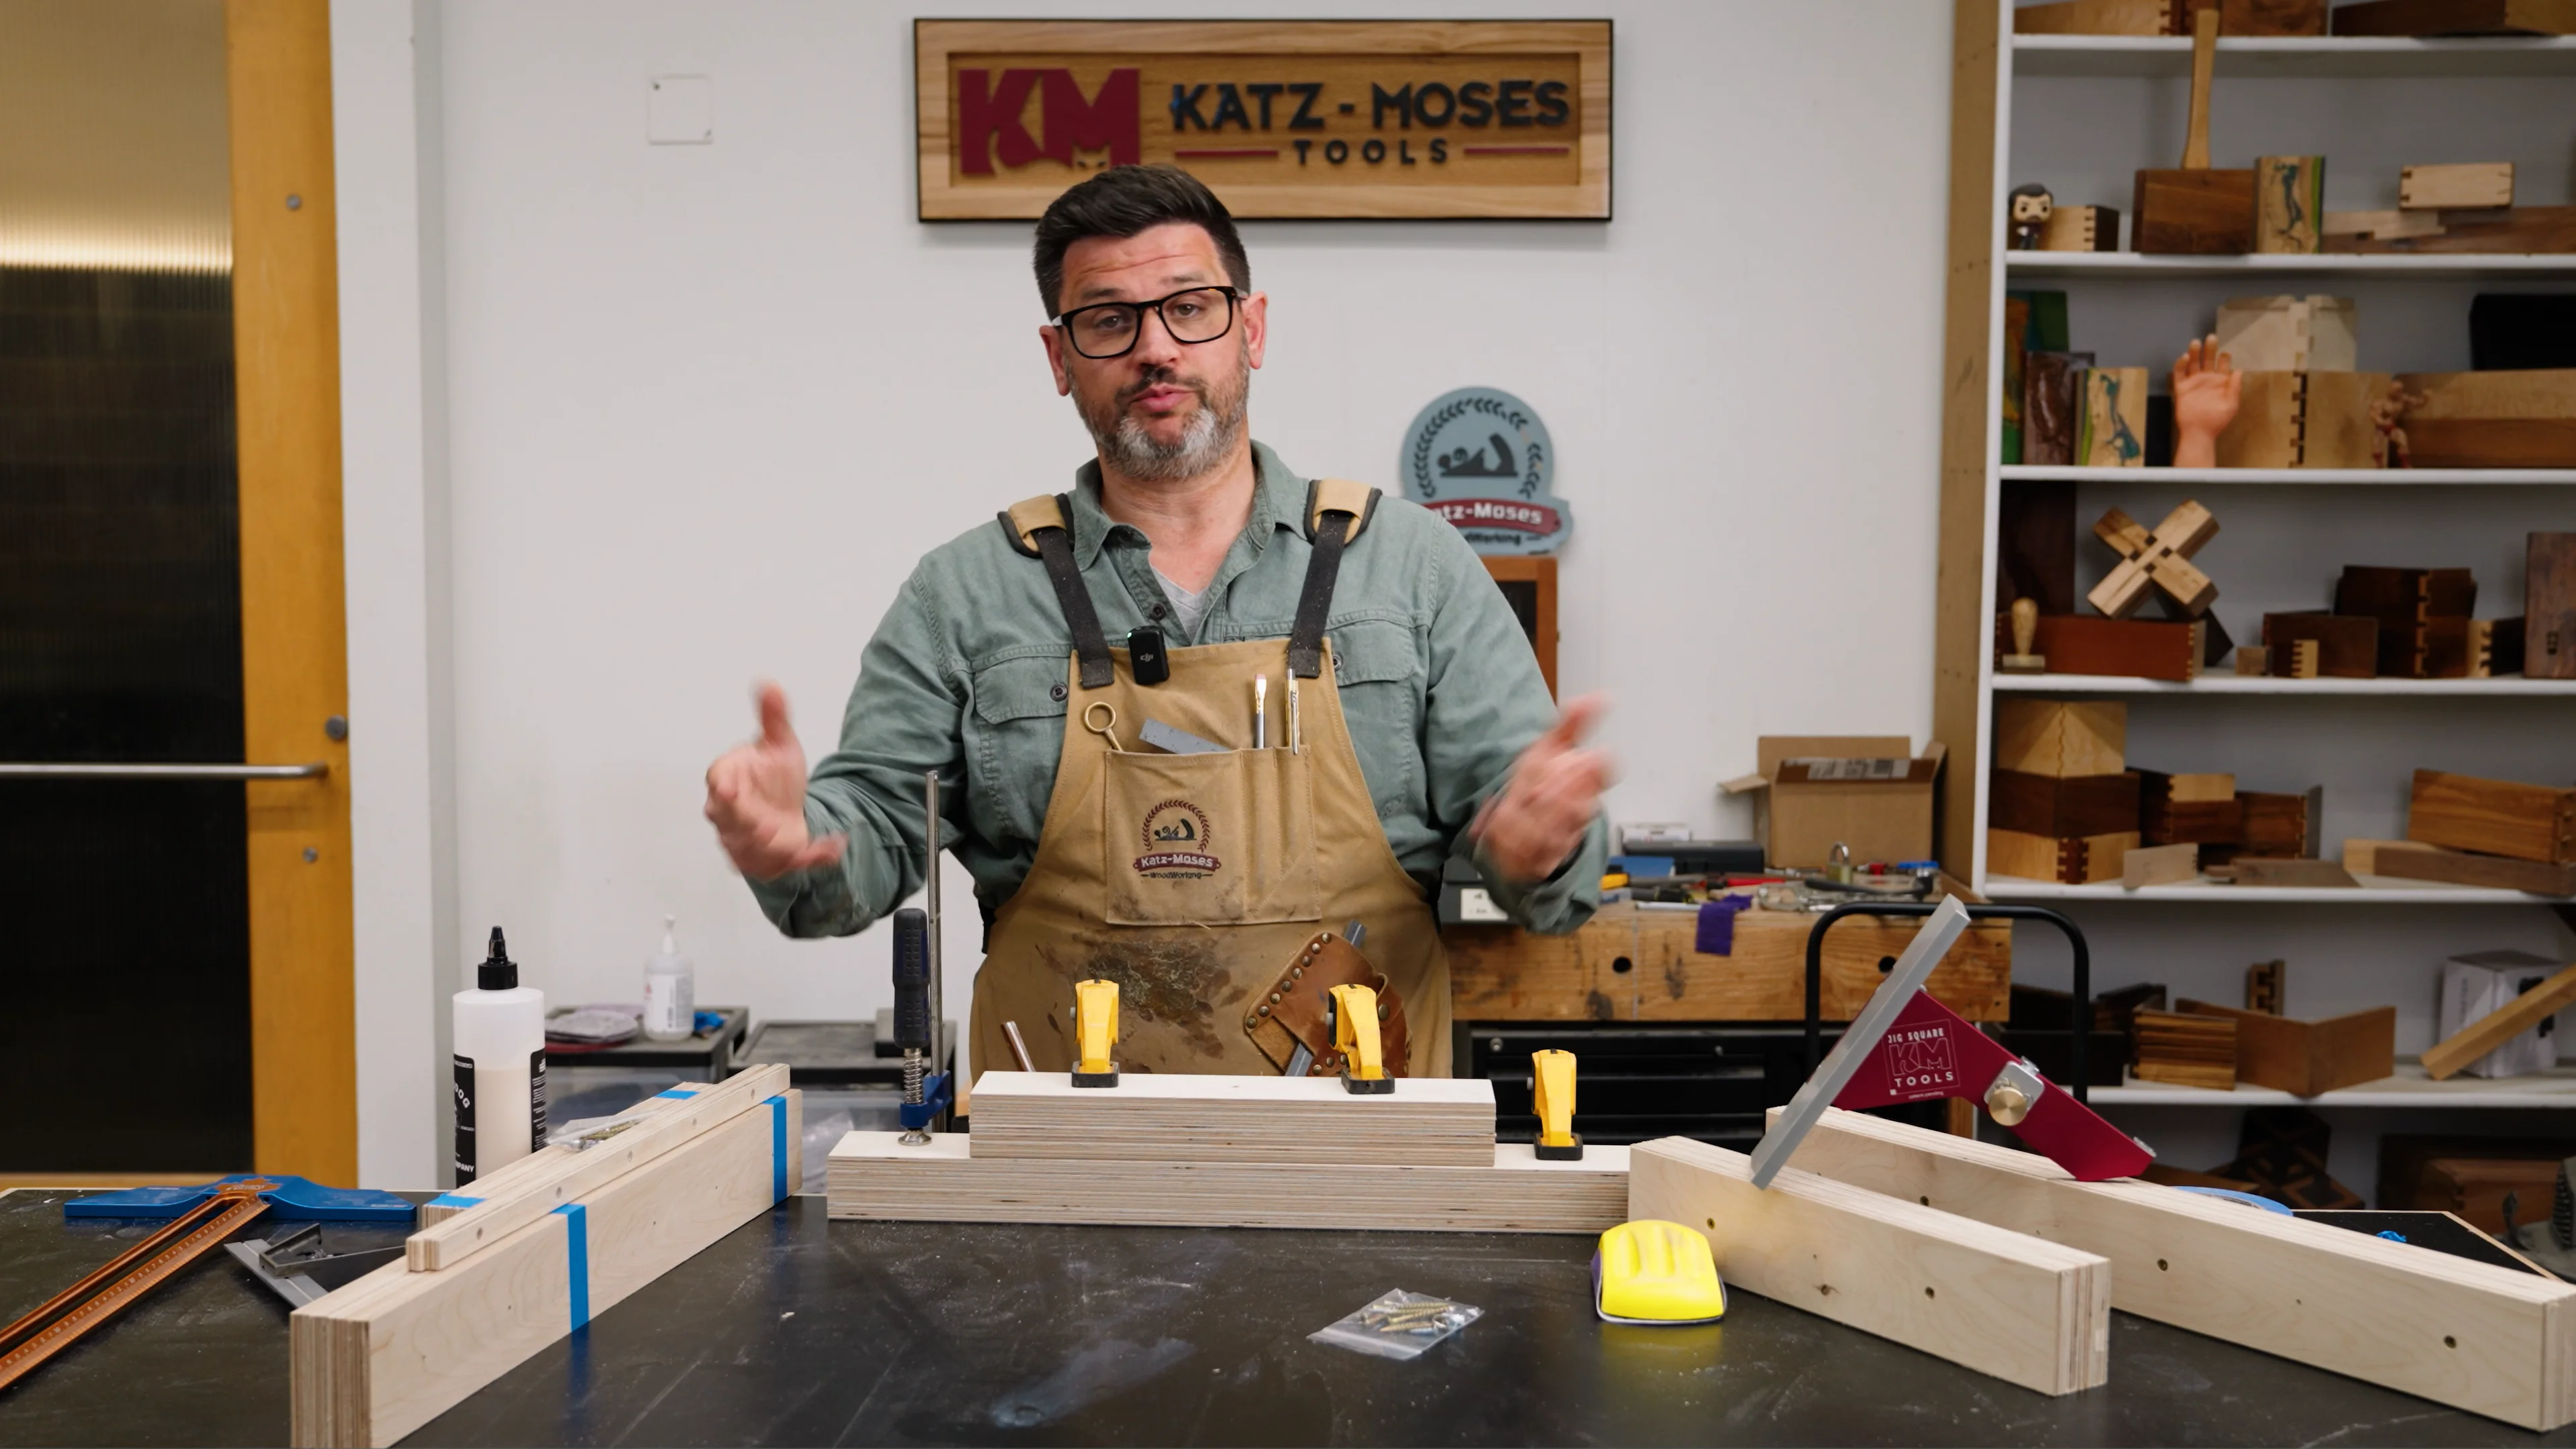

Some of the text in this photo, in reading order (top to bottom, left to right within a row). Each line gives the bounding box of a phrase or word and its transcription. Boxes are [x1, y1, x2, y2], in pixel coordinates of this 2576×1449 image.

[1171, 83, 1325, 130] KATZ
[1372, 80, 1570, 129] MOSES
[958, 68, 1140, 178] KM
[1293, 138, 1448, 165] TOOLS
[1432, 502, 1542, 525] tz-Moses
[1141, 854, 1214, 867] Katz-Moses
[1888, 1028, 1944, 1043] JIG SQUARE
[1894, 1071, 1953, 1087] TOOLS
